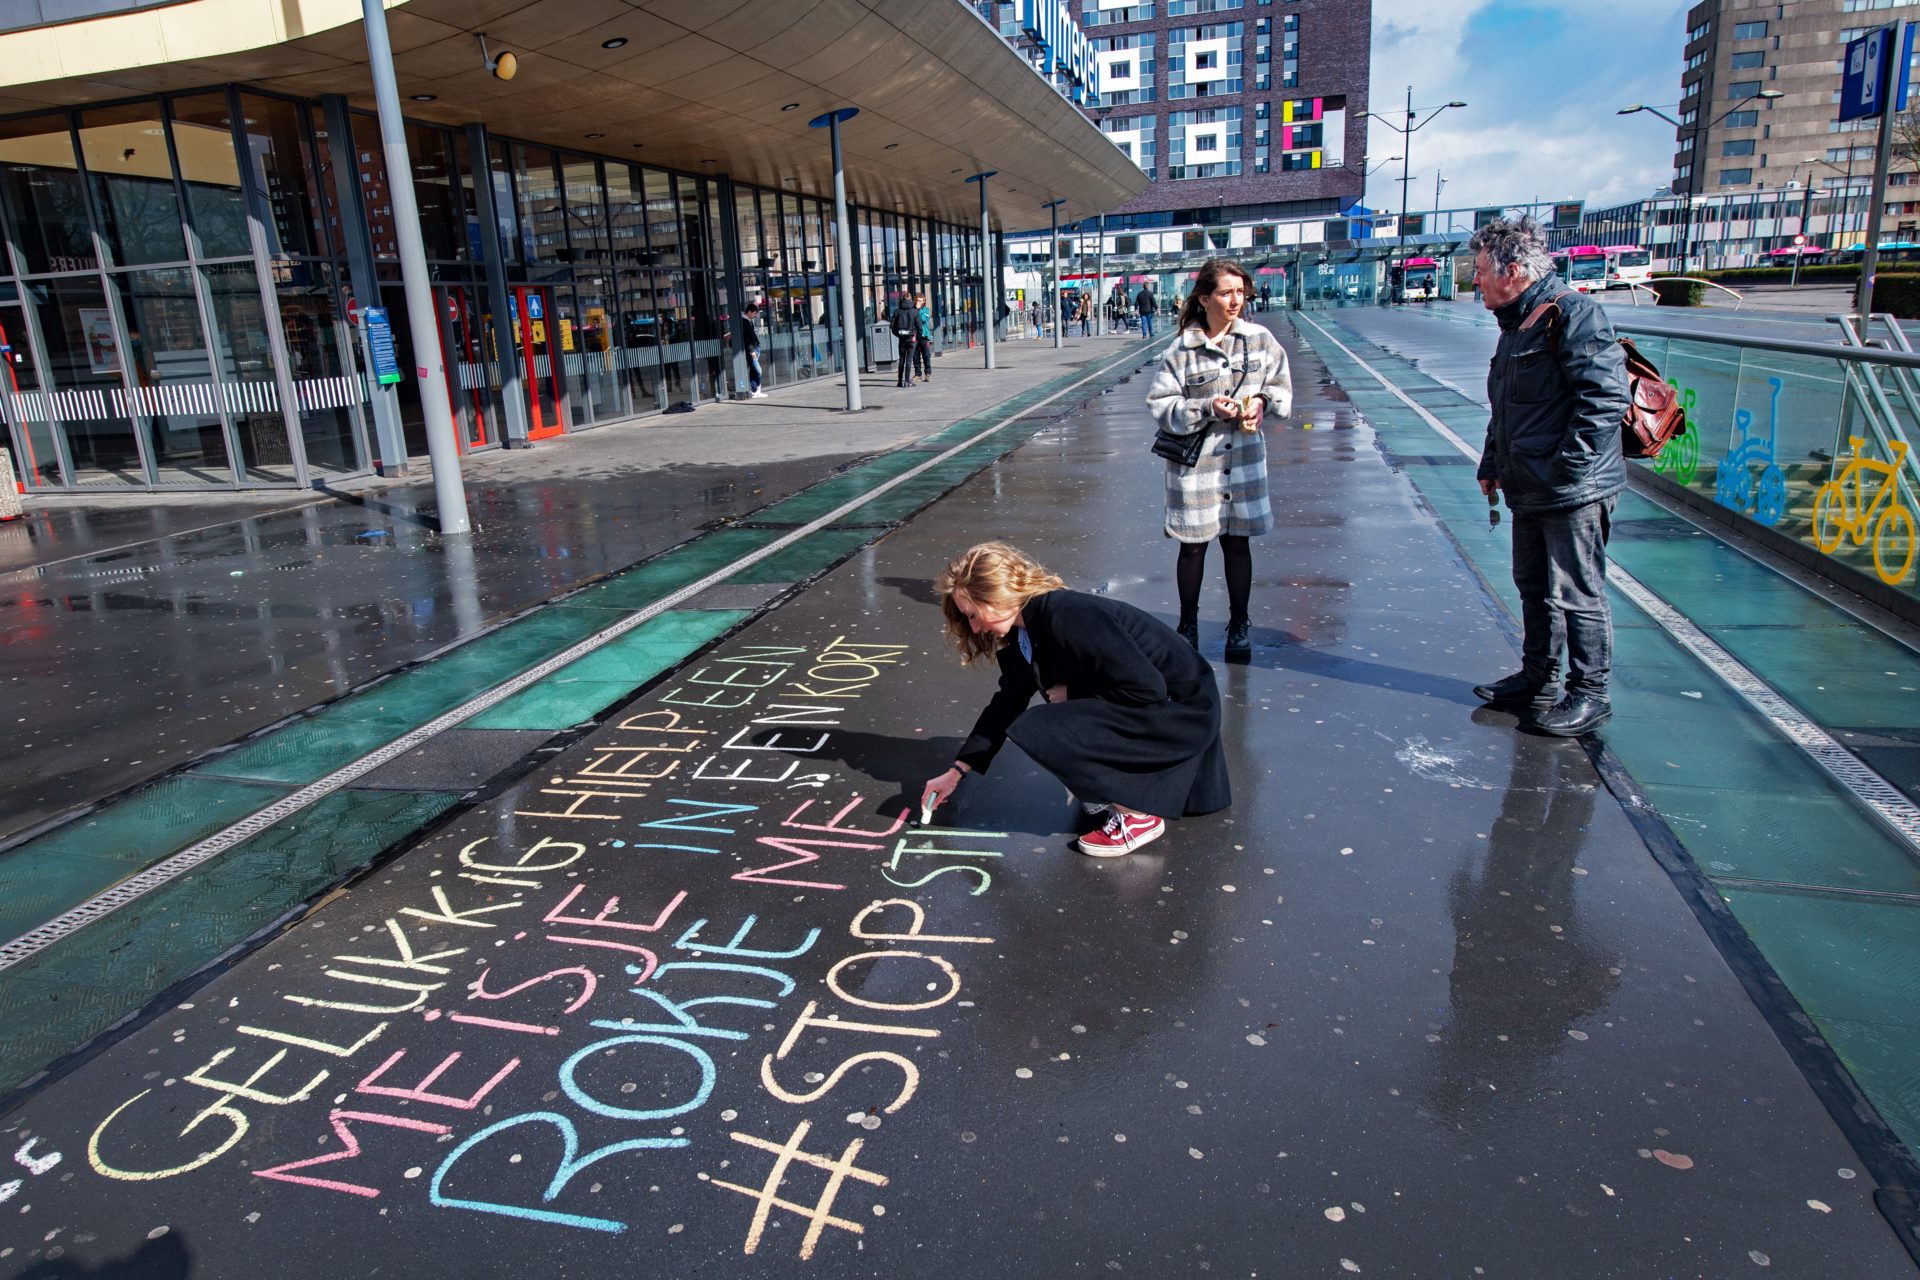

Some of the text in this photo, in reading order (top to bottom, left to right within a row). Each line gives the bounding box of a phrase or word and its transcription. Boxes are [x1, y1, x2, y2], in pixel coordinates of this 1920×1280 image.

[658, 646, 807, 709] EEN
[692, 704, 844, 782] EEN
[779, 635, 909, 698] KORT
